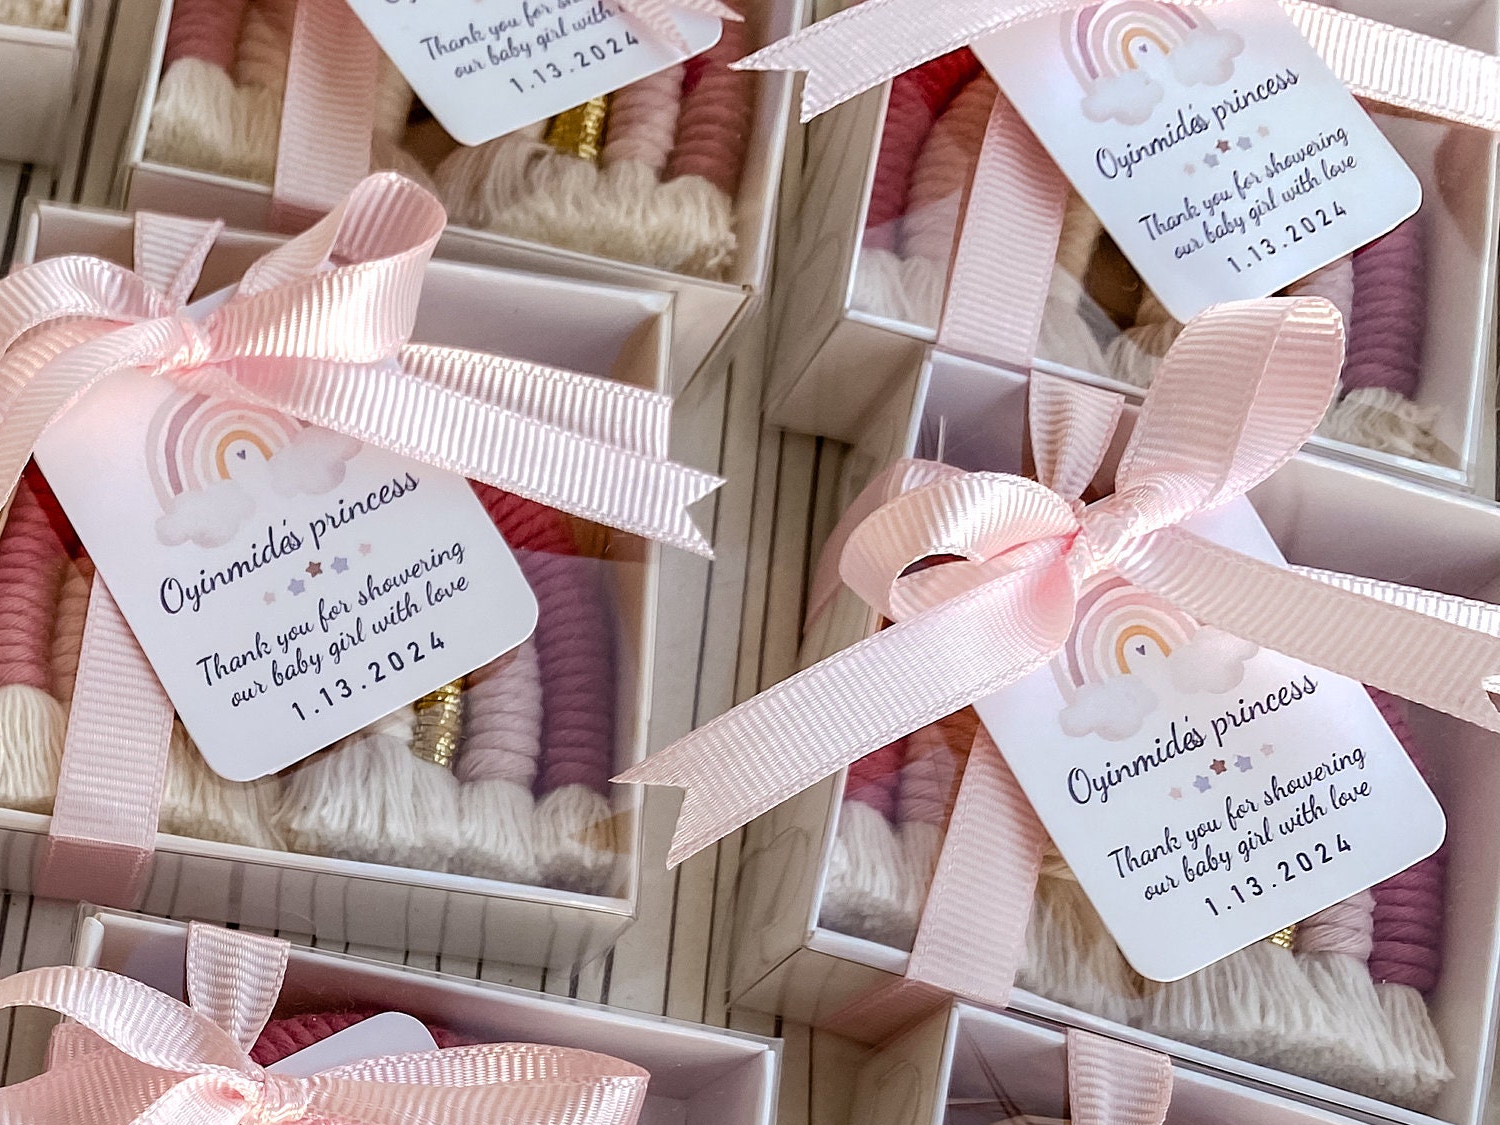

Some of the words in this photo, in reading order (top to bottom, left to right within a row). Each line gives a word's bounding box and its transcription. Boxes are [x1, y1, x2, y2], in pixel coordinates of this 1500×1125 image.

[418, 22, 485, 61] Thank
[488, 17, 521, 40] you
[522, 0, 552, 27] for
[454, 59, 486, 78] our
[486, 36, 532, 65] baby
[535, 16, 568, 51] girl
[572, 0, 616, 31] with
[1211, 69, 1299, 130] princess
[1138, 196, 1200, 241] Thank
[1202, 189, 1233, 216] you
[1232, 169, 1262, 199] for
[1264, 127, 1349, 177] showering
[1173, 237, 1204, 259] our
[1202, 210, 1246, 243] baby
[1248, 186, 1278, 226] girl
[1281, 166, 1322, 202] with
[1320, 155, 1358, 180] love
[1226, 201, 1347, 272] 1.13.2024
[309, 473, 420, 550] princess
[195, 631, 271, 686] Thank
[276, 621, 314, 653] you
[318, 597, 351, 632] for
[358, 542, 465, 605] showering
[230, 680, 268, 707] our
[271, 646, 321, 686] baby
[327, 616, 365, 664] girl
[371, 591, 423, 634] with
[426, 575, 469, 606] love
[292, 631, 445, 720] 1.13.2024
[1211, 677, 1319, 749] princess
[1107, 826, 1181, 878] Thank
[1185, 819, 1222, 849] you
[1225, 795, 1258, 830] for
[1263, 748, 1366, 805] showering
[1144, 875, 1180, 900] our
[1182, 843, 1231, 882] baby
[1237, 815, 1273, 862] girl
[1278, 793, 1328, 834] with
[1329, 781, 1372, 809] love
[1204, 834, 1351, 916] 1.13.2024
